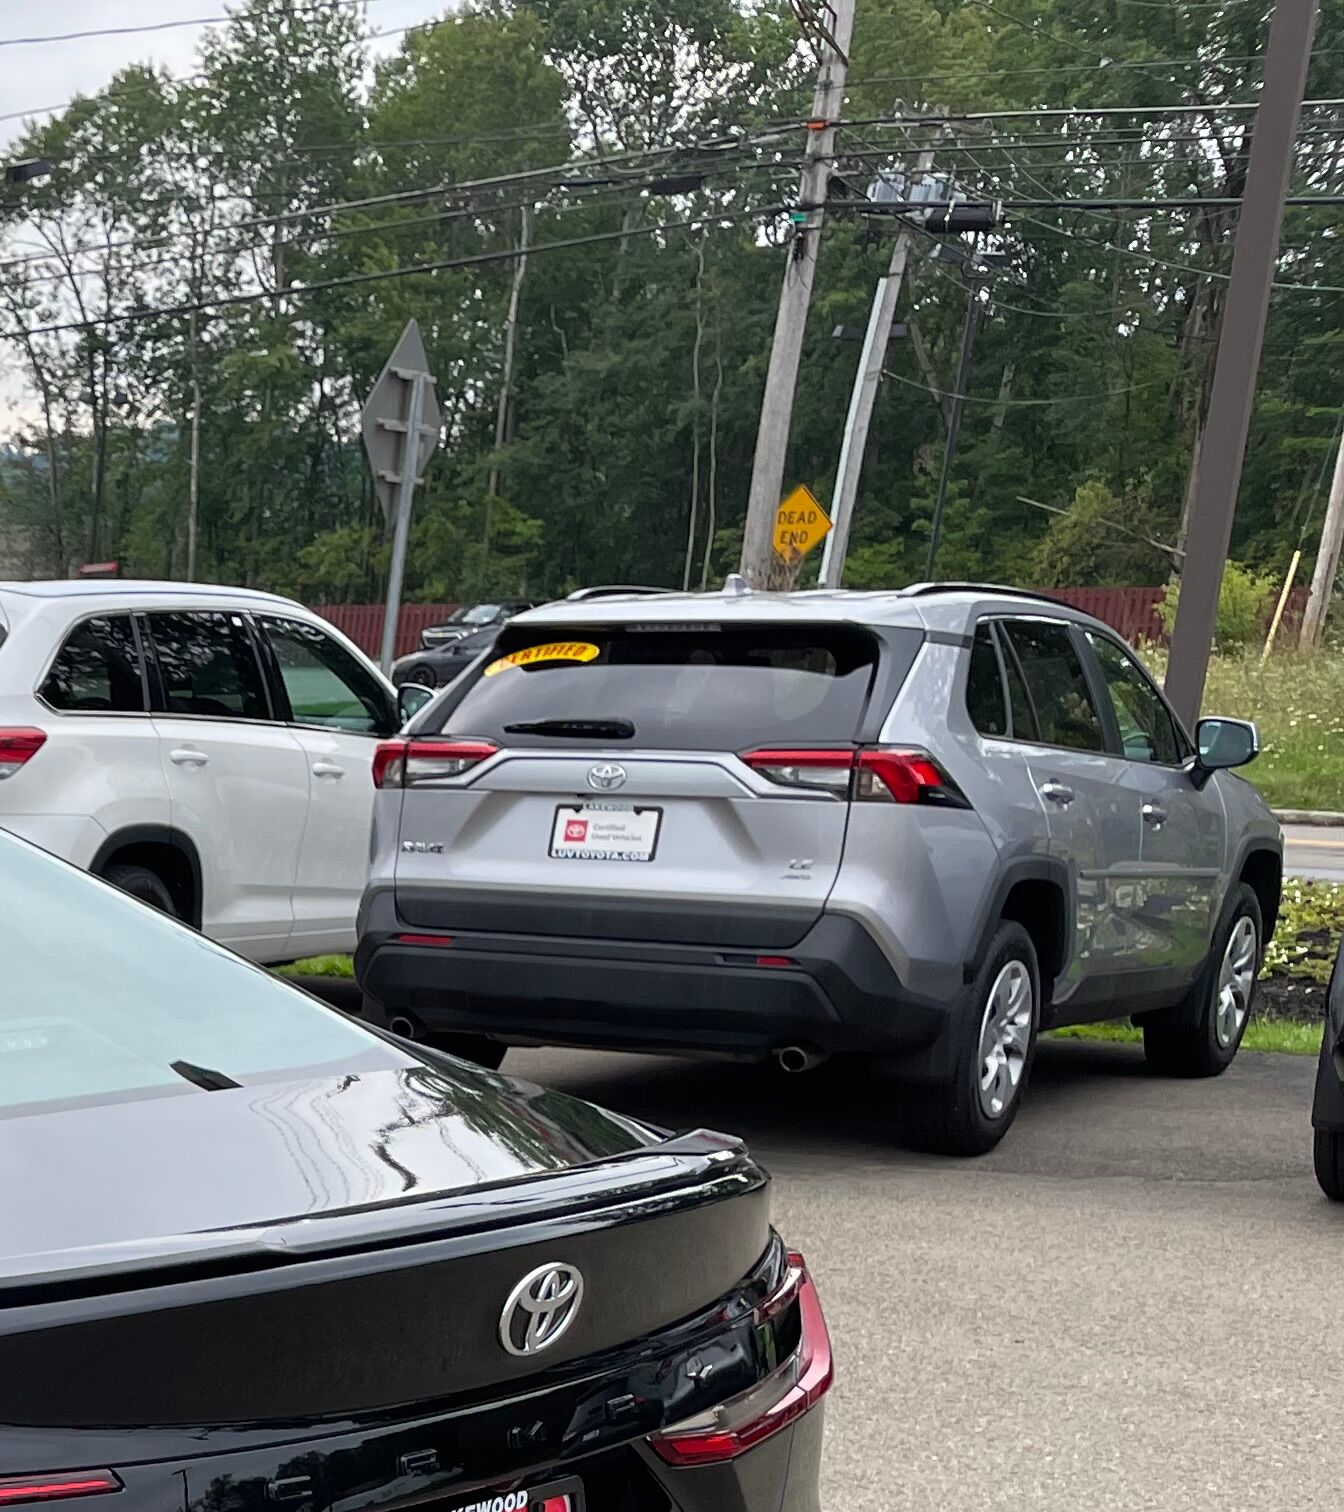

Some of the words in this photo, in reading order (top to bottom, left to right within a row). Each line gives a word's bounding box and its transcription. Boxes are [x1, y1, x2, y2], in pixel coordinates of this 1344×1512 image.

[777, 510, 817, 525] DEAD
[779, 530, 808, 545] END
[552, 848, 650, 861] LUVTOYOTA.COM
